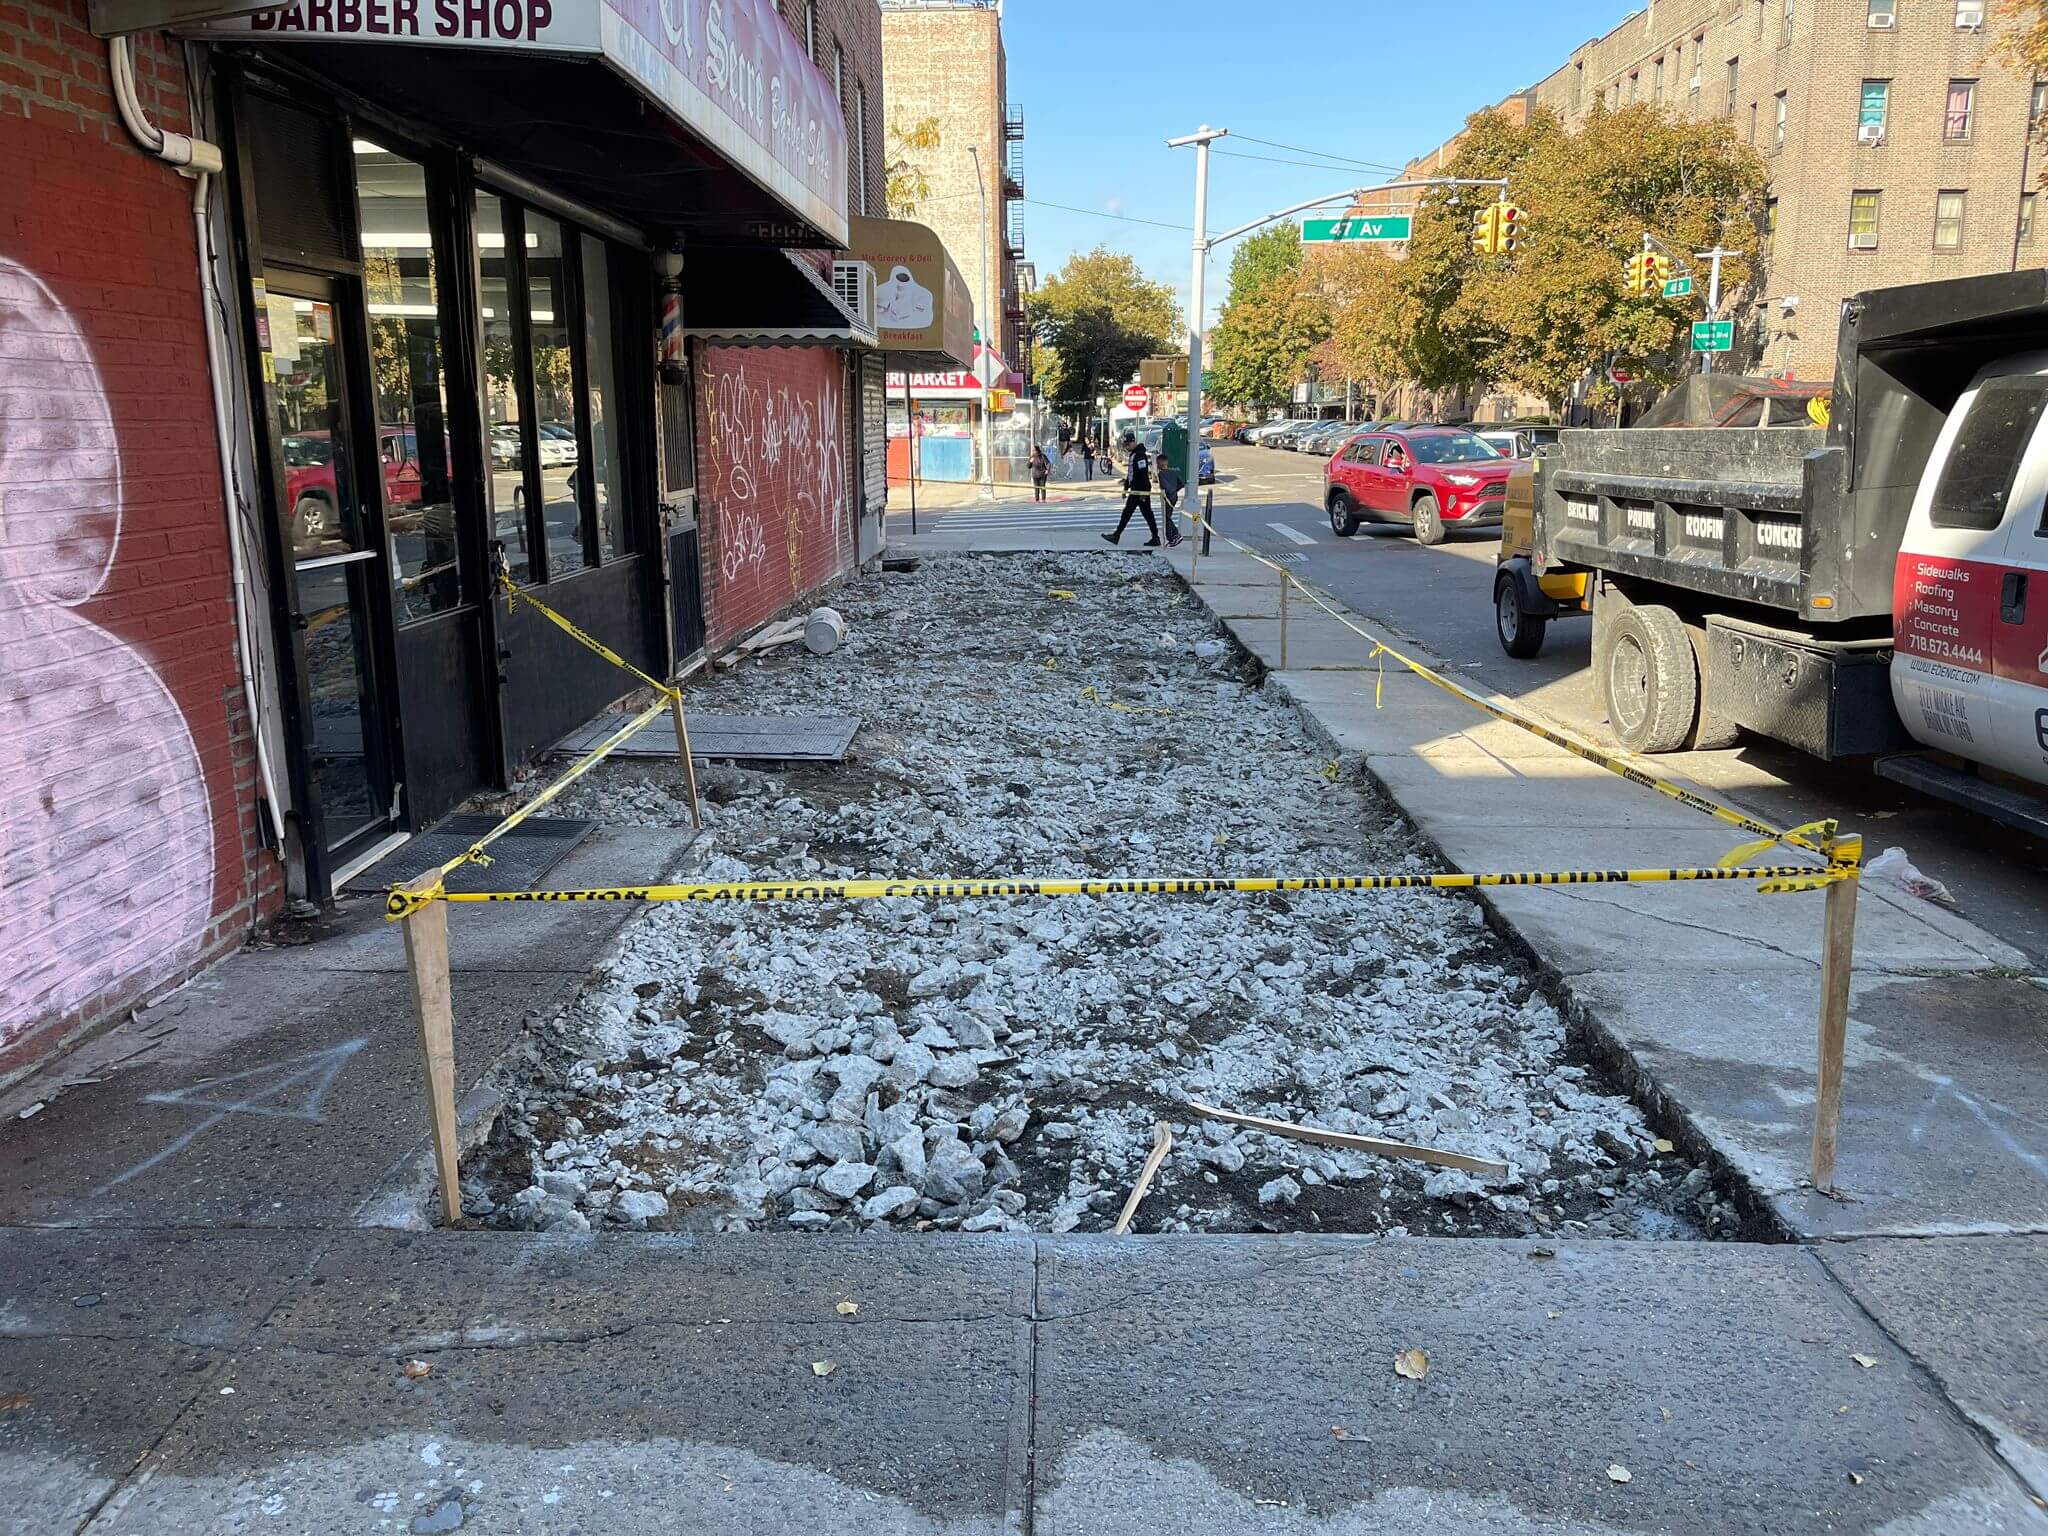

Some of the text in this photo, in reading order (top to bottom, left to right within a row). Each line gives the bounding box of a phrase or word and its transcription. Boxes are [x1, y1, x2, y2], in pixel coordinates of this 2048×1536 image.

[434, 0, 553, 41] SHOP
[1329, 221, 1383, 237] 47 Av
[883, 331, 923, 340] Breakfast
[1916, 562, 1970, 582] Sidewalks
[1915, 581, 1954, 602] Roofing
[1914, 598, 1959, 621] Masonry
[1914, 617, 1960, 637] Concrete
[1909, 633, 1984, 664] 718.673.4444
[688, 886, 846, 901] CAUTION
[884, 883, 1041, 897] CAUTION
[1080, 879, 1236, 893] CAUTION
